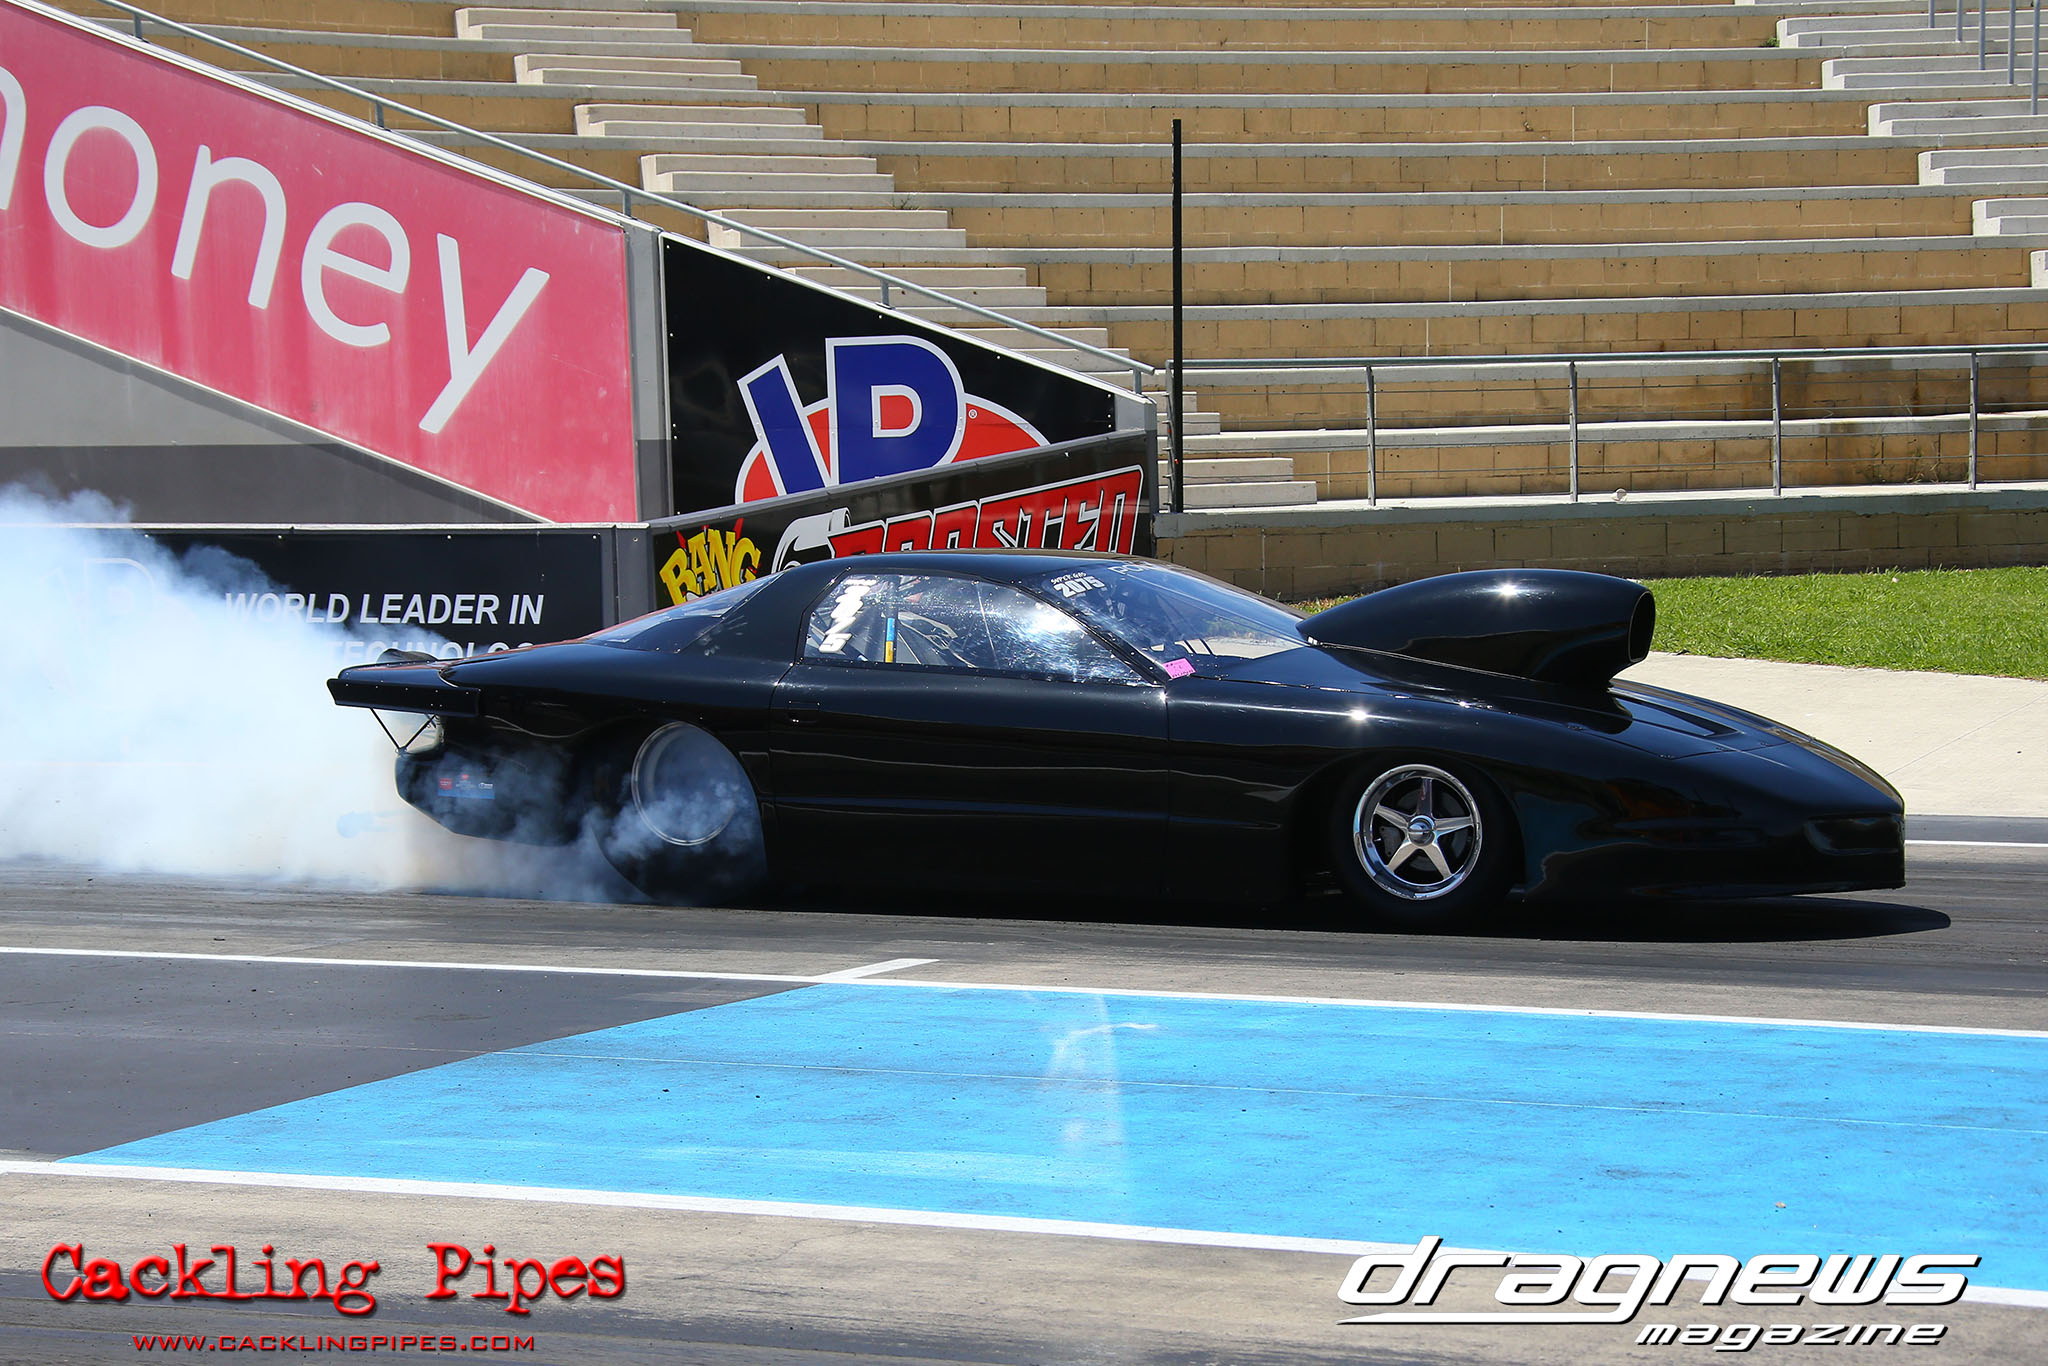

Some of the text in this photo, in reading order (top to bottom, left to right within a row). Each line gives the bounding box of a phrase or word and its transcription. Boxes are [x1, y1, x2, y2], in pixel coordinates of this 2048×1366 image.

[659, 528, 762, 606] BANG
[1053, 576, 1105, 598] 2075
[224, 592, 544, 625] WORLD LEADER IN
